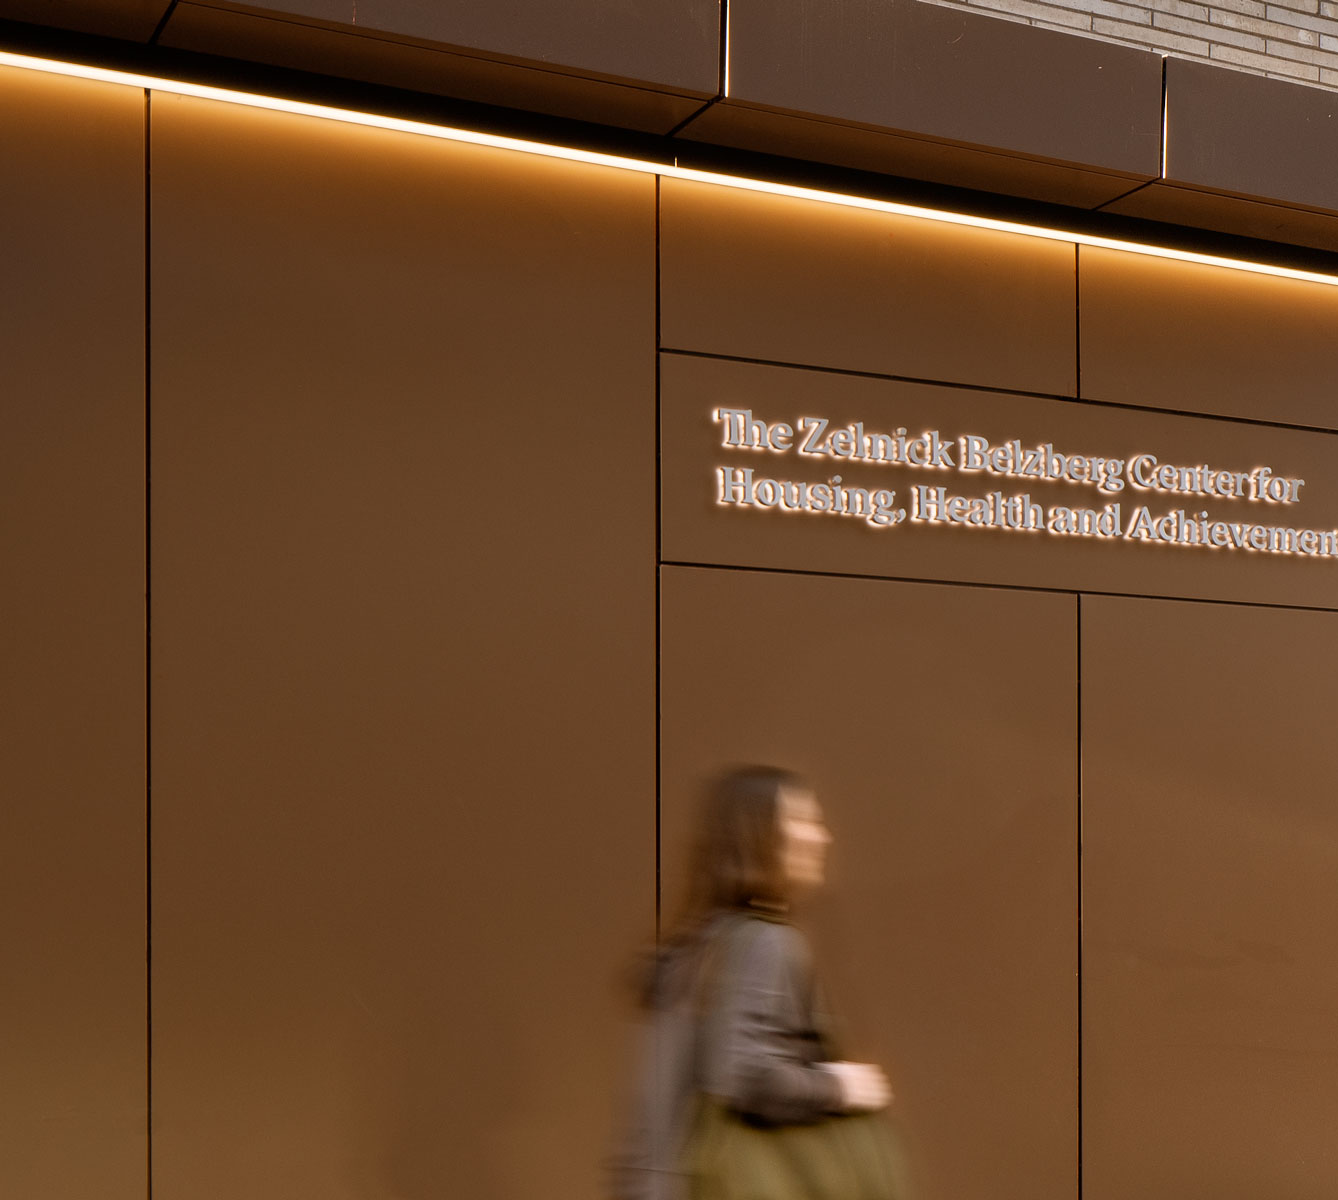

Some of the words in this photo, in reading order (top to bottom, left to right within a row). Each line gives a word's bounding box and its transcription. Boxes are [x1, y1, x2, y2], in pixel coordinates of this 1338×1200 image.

[716, 408, 794, 450] The
[801, 417, 955, 468] Zelnick
[963, 435, 1124, 493] Belzberg
[1131, 454, 1249, 498] Center
[1251, 467, 1305, 503] for
[718, 467, 907, 525] Housing,
[912, 485, 1045, 532] Health
[1050, 503, 1122, 538] and
